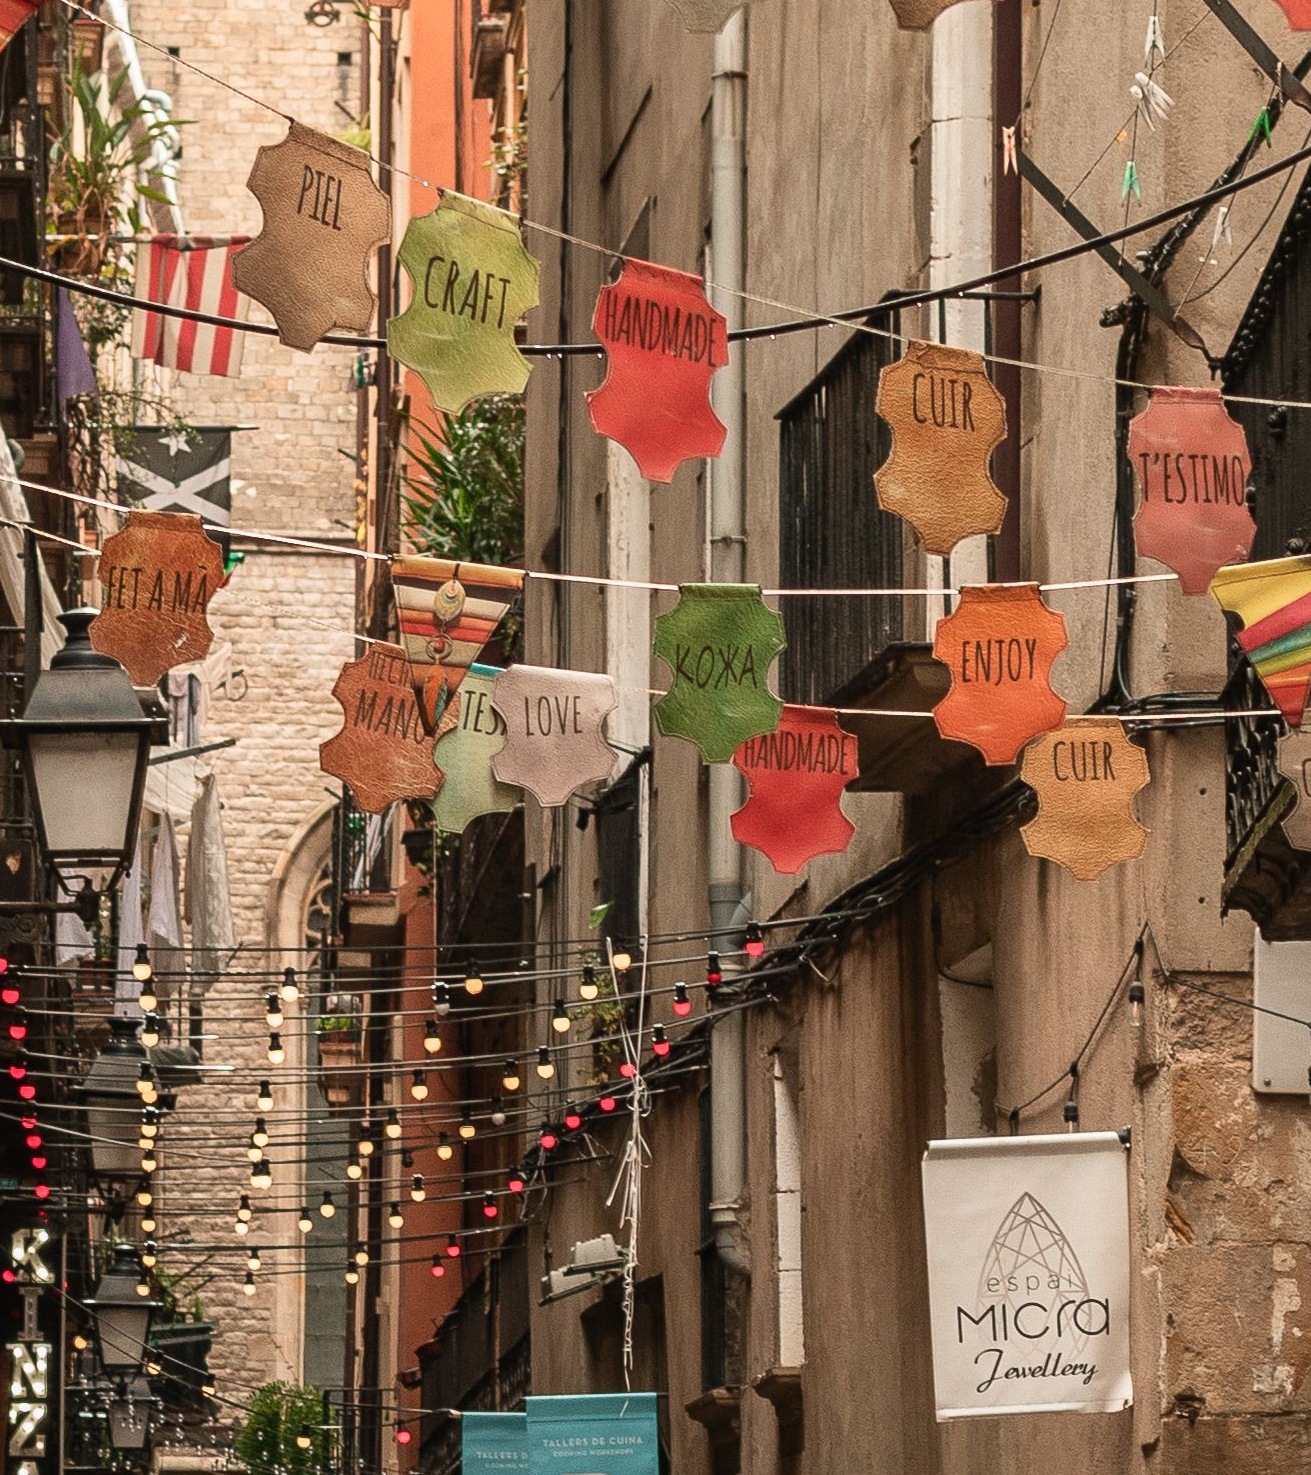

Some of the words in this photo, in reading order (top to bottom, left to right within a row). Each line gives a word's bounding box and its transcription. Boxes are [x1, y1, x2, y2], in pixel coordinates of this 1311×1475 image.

[298, 164, 343, 231] PIEL
[424, 255, 511, 329] CRAFT
[604, 292, 717, 367] HANDMADE
[912, 372, 976, 433] CUIR
[1139, 452, 1245, 507] T'ESTIMO
[105, 565, 142, 611] FET
[147, 569, 165, 611] A
[961, 638, 1037, 687] ENJOY
[524, 695, 583, 738] LOVE
[744, 731, 849, 776] HANDMADE
[1053, 739, 1116, 782] CUIR
[974, 1348, 1098, 1393] Jewellery
[543, 1438, 588, 1449] TALLERS
[591, 1437, 606, 1446] DE
[609, 1436, 643, 1445] CUINA
